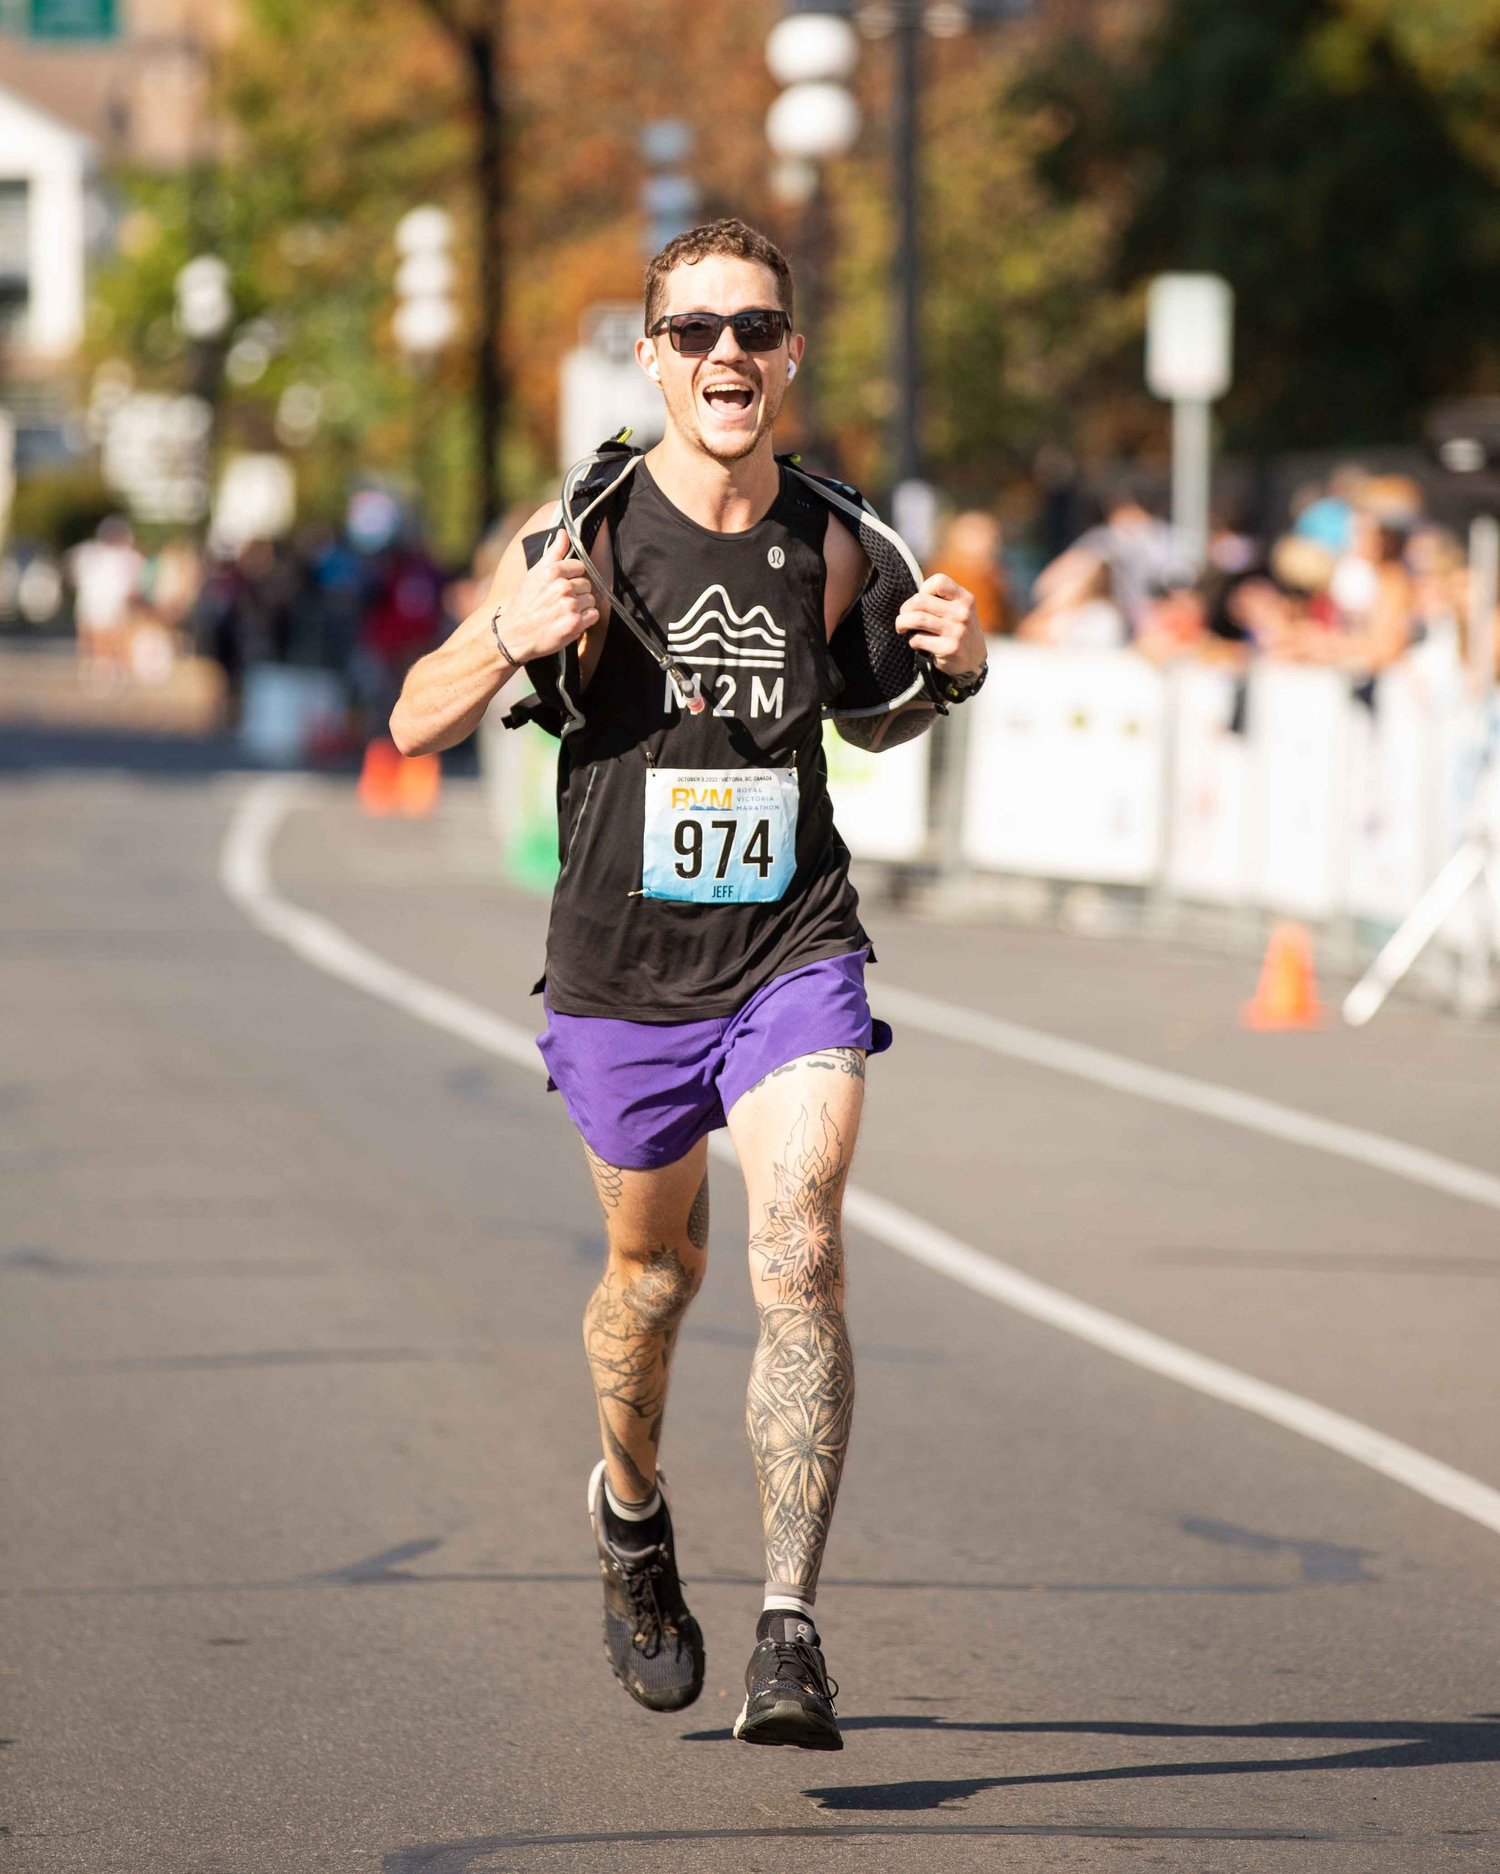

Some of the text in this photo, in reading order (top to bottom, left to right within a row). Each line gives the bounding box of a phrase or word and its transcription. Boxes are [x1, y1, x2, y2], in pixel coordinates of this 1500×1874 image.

[672, 787, 733, 811] RVM
[674, 819, 774, 879] 974
[711, 885, 734, 898] JEFF
